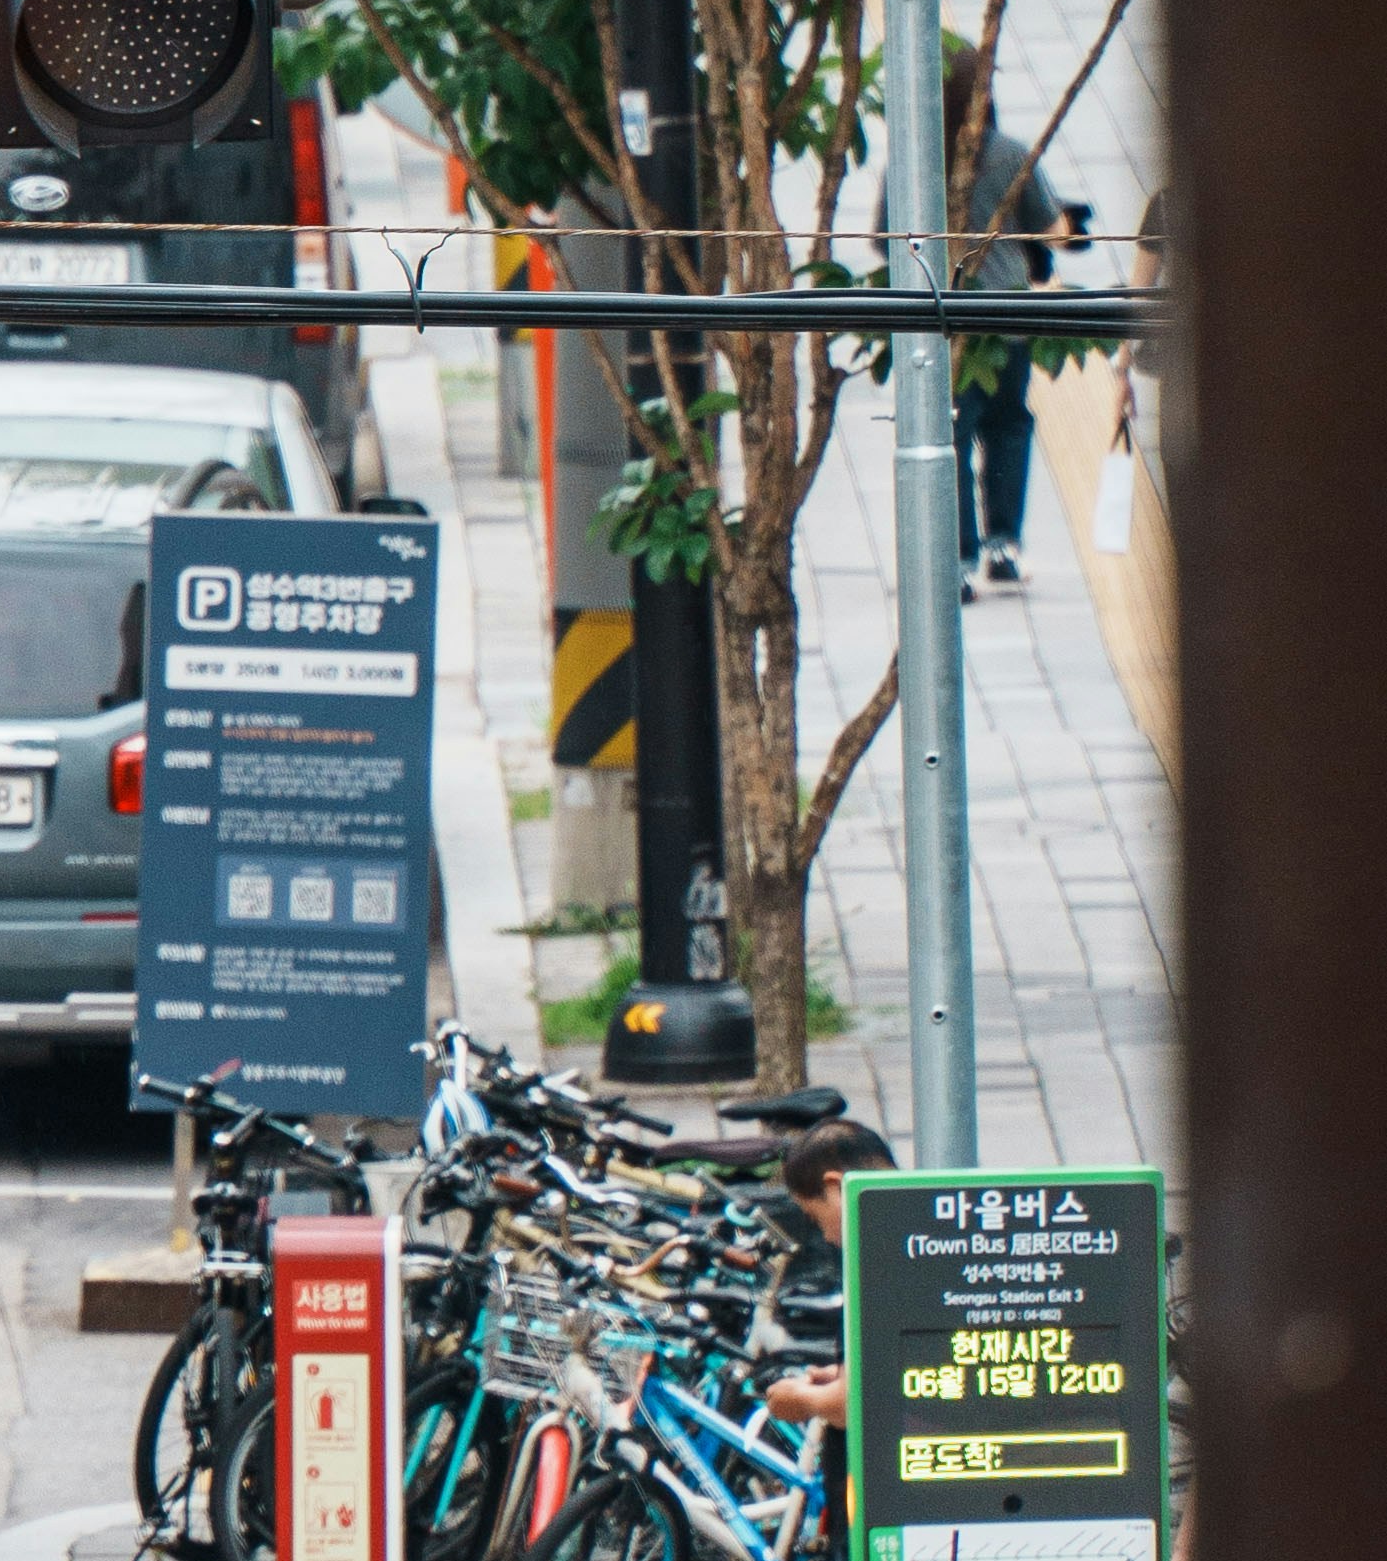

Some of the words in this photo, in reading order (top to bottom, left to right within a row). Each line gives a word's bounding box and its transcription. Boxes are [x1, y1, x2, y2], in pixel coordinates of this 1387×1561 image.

[246, 600, 384, 635] 공영주차장
[935, 1189, 1089, 1230] 마을버스
[907, 1234, 968, 1259] (Town
[971, 1233, 1006, 1256] Bus
[962, 1261, 1065, 1284] 성수역3번출구
[297, 1283, 367, 1312] 사용법
[943, 1290, 998, 1306] Seongsu
[999, 1288, 1045, 1304] Station
[1047, 1288, 1073, 1303] Exit
[1073, 1288, 1085, 1302] 3
[951, 1329, 1074, 1365] 현재시간
[903, 1366, 965, 1400] 06월
[977, 1364, 1036, 1398] 15일
[1046, 1363, 1125, 1394] 12:00
